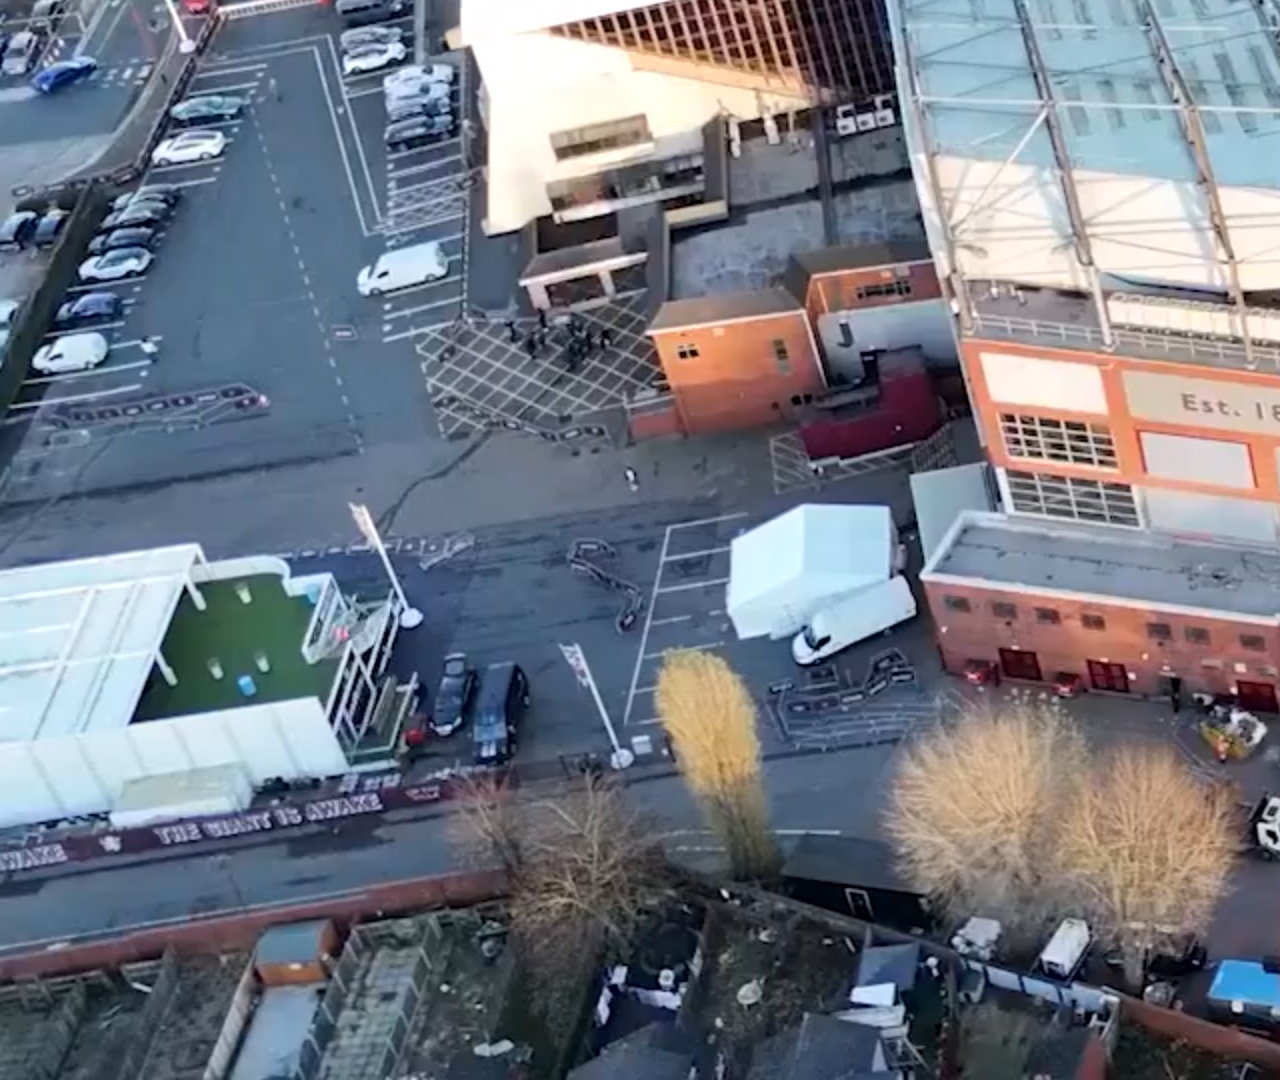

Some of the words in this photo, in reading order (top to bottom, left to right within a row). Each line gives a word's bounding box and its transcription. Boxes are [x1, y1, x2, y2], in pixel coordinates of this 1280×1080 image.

[1180, 392, 1241, 418] Est.
[153, 822, 202, 845] THE
[273, 806, 302, 826] IS
[305, 792, 384, 821] AWAKE
